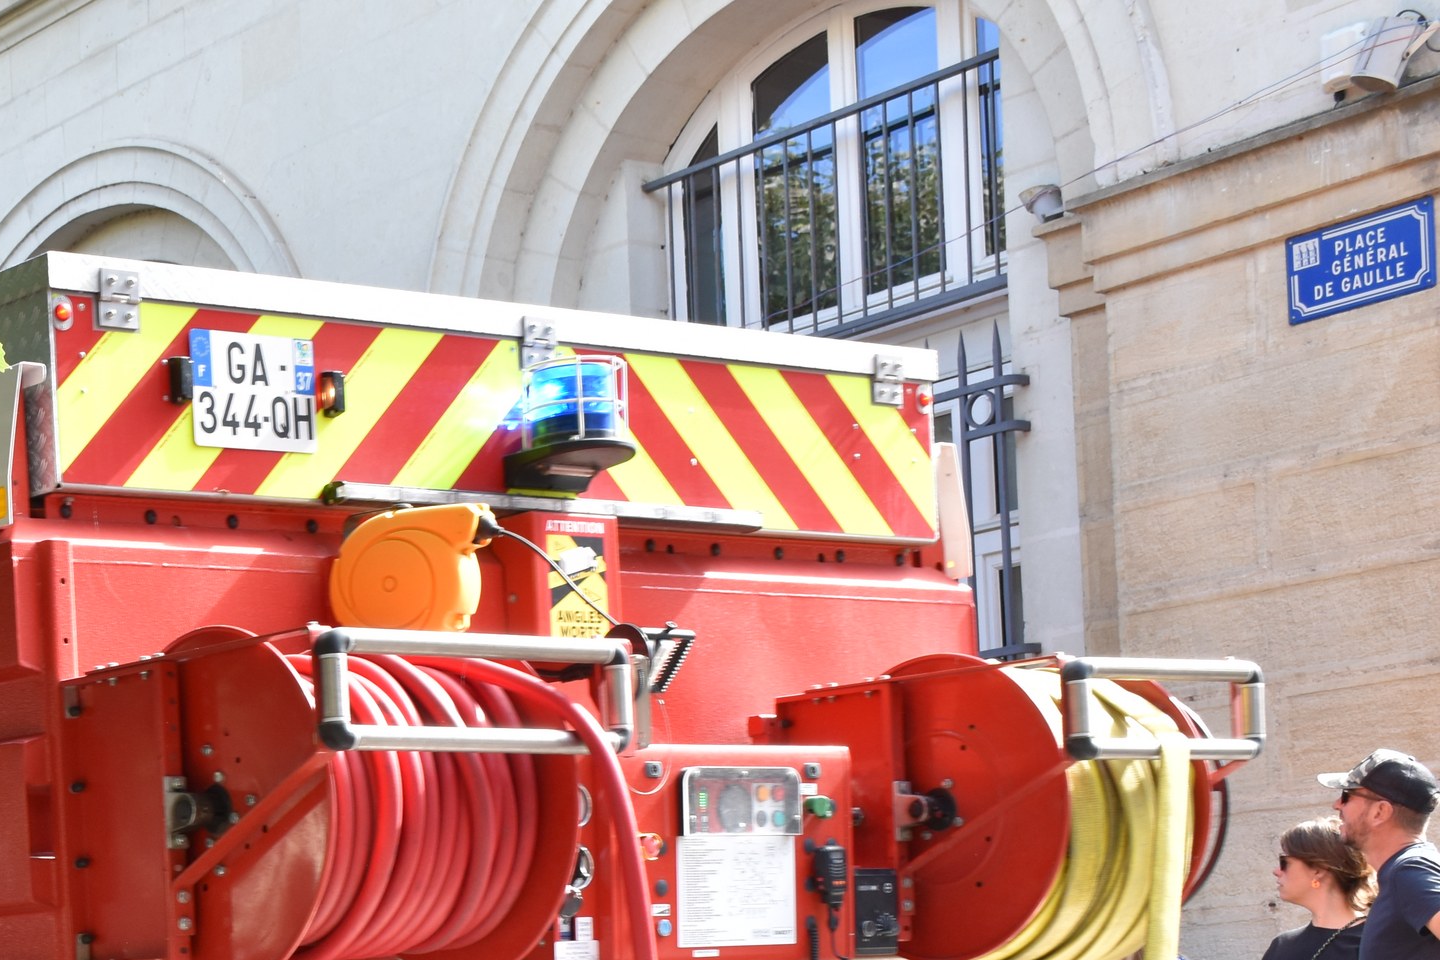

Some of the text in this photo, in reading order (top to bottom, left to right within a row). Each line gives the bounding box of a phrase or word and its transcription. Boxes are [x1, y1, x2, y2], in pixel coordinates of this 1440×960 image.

[1334, 227, 1386, 256] PLACE
[1331, 241, 1409, 275] GÉNÉRAL
[1314, 261, 1405, 300] DE GAULLE
[197, 364, 207, 378] F
[296, 371, 312, 391] 37
[199, 391, 313, 441] 344-QH
